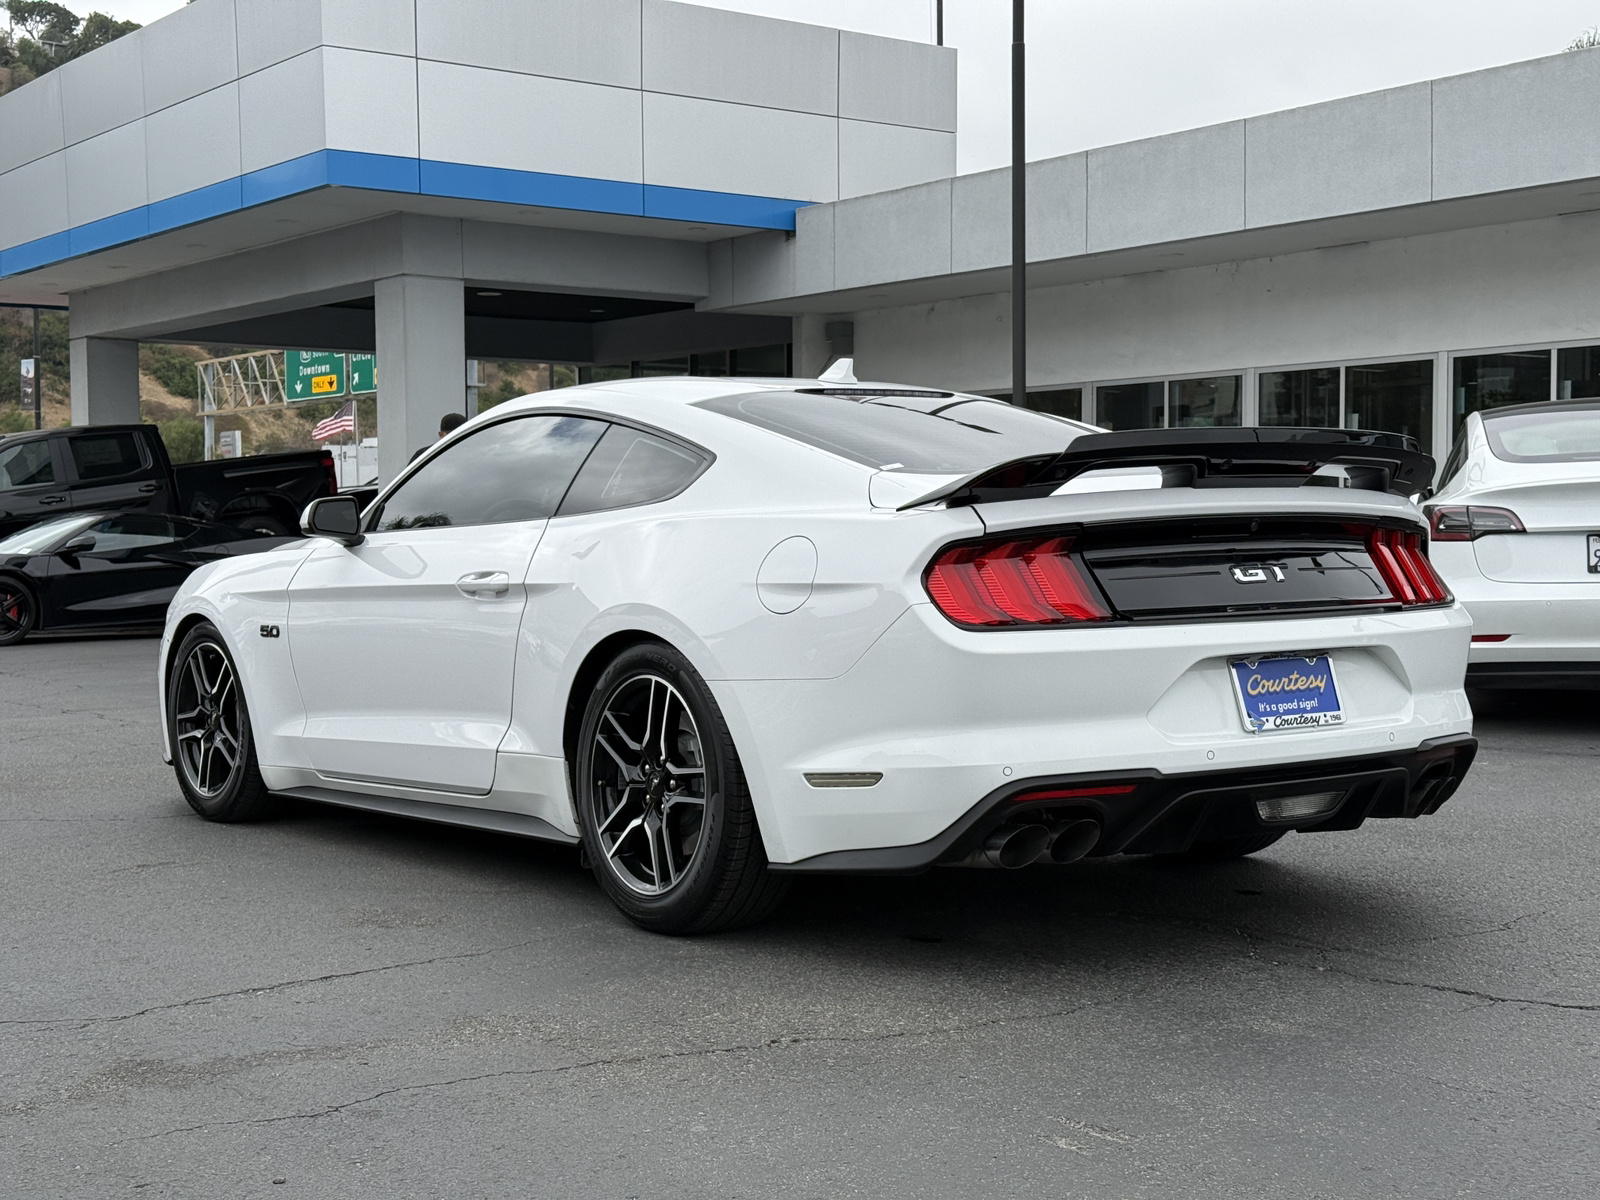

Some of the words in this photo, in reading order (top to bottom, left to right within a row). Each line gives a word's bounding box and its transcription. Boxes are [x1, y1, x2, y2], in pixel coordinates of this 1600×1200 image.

[299, 364, 330, 376] Downtown
[1229, 564, 1288, 584] GT
[1247, 670, 1327, 695] Courtesy
[1258, 702, 1270, 712] It's
[1278, 698, 1298, 713] good
[1299, 697, 1318, 710] sign!
[1273, 712, 1321, 728] Courtesy
